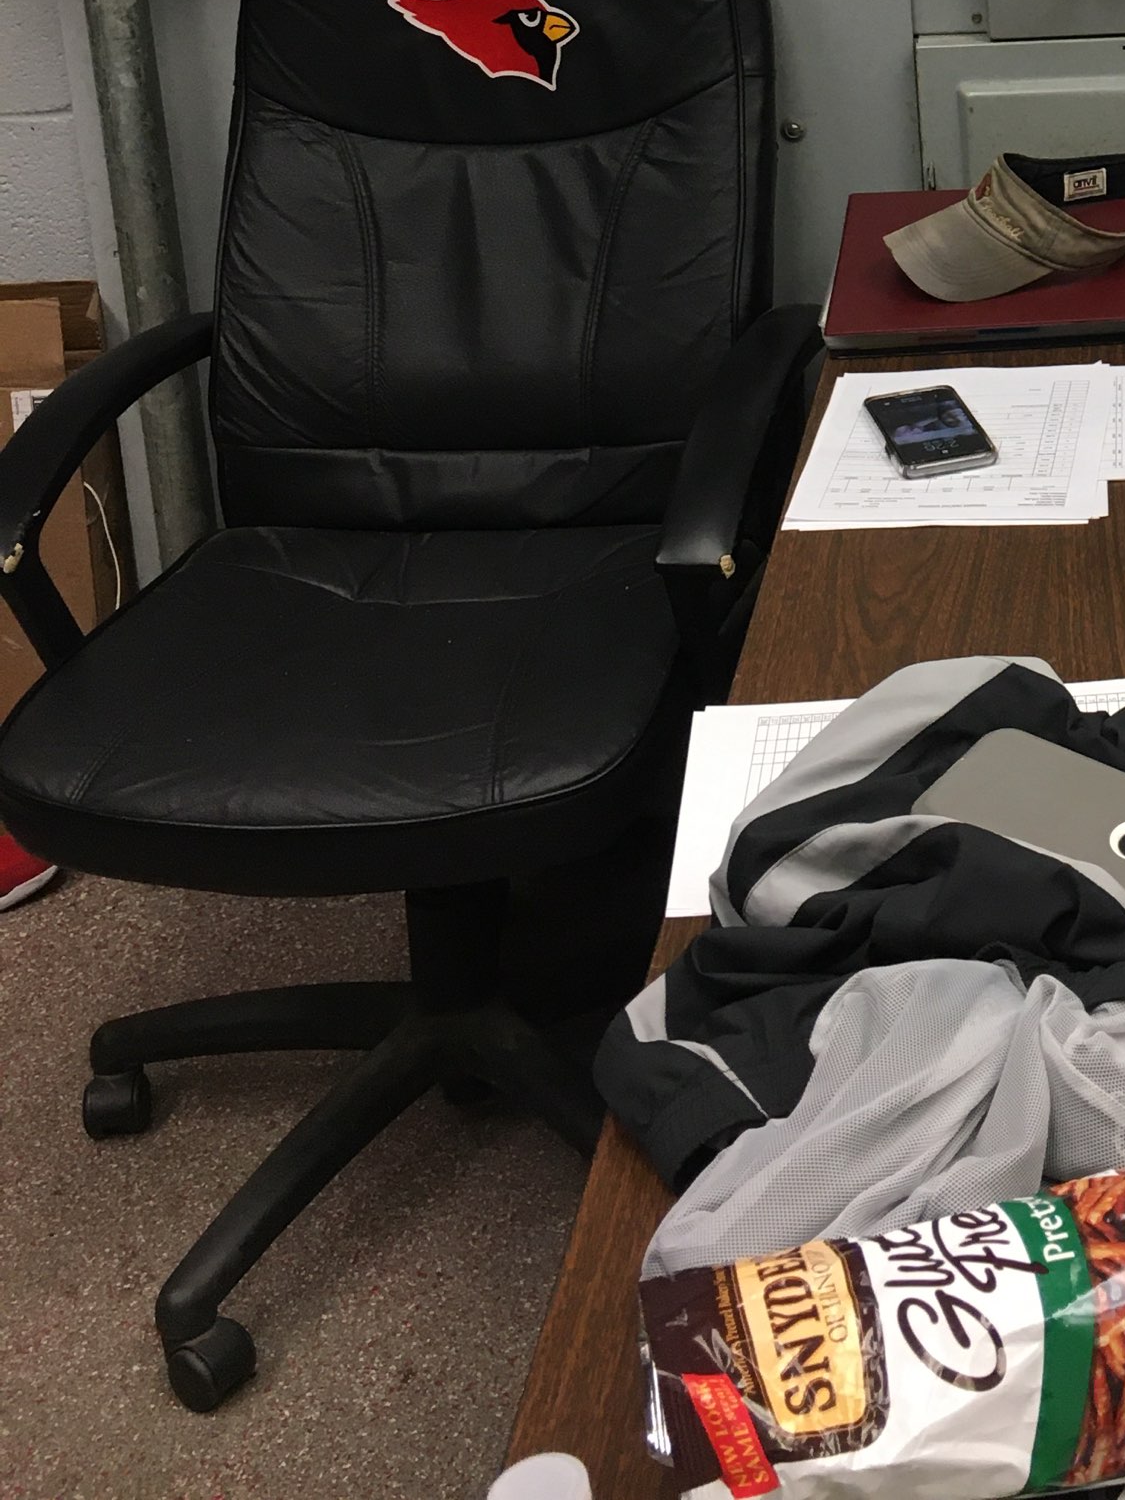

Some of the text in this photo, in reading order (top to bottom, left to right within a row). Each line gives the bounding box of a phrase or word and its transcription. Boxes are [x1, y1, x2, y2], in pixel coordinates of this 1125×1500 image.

[1072, 174, 1098, 190] anvil
[720, 1309, 740, 1341] Pretzel
[691, 1381, 753, 1488] NEW LOOK
[731, 1422, 770, 1484] SAME
